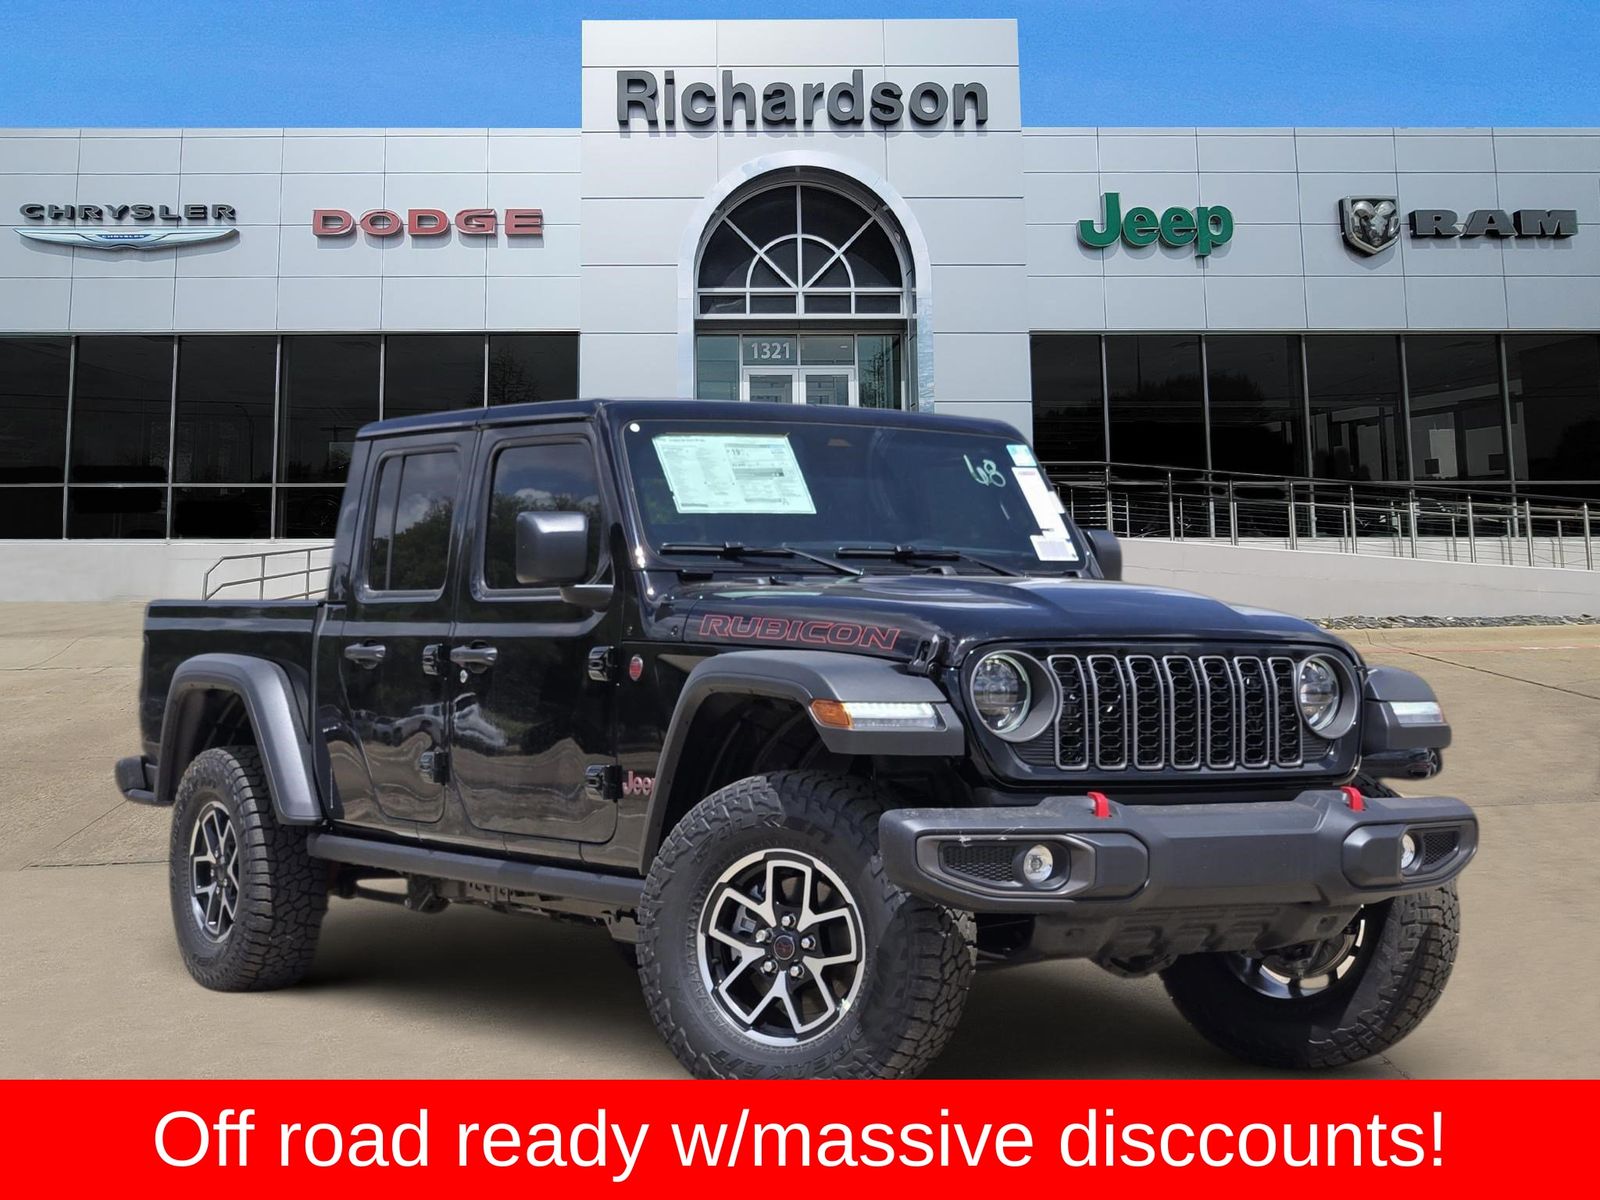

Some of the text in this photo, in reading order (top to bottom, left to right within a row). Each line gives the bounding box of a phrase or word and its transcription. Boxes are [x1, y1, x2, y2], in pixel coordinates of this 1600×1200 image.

[616, 69, 988, 126] Richardson
[19, 202, 237, 221] CHRYSLER
[312, 208, 544, 237] DODGE
[1076, 191, 1234, 257] Jeep
[1408, 209, 1578, 239] RAM
[751, 342, 790, 359] 1321
[699, 613, 900, 651] RUBICON
